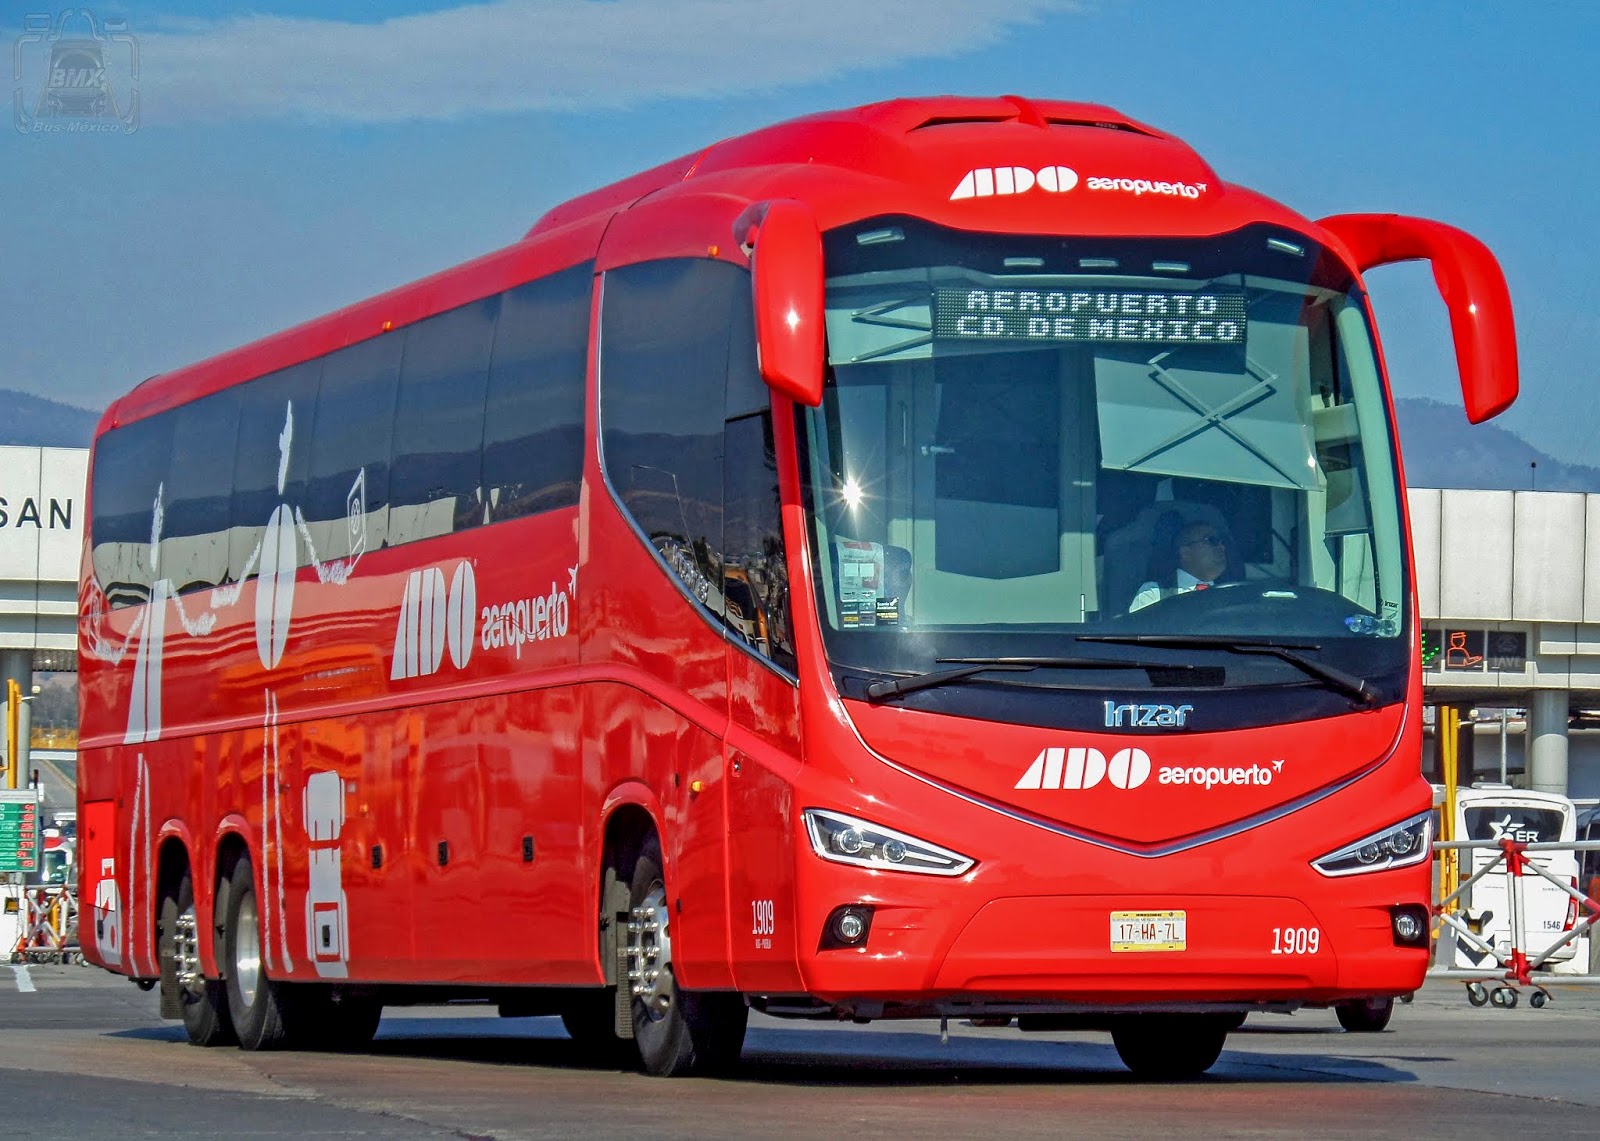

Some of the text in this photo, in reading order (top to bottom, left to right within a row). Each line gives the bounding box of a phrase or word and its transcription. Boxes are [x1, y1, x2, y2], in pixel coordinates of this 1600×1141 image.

[949, 165, 1199, 201] ADO aeropuerto
[966, 289, 1218, 315] AEROPUERTO
[956, 315, 1238, 340] CD. DE MEXICO
[0, 496, 73, 530] SAN
[389, 560, 569, 681] ADO aeropuerto
[1013, 747, 1273, 790] ADO aeropuerto
[751, 899, 774, 935] 1909
[1119, 922, 1180, 940] 17-HA-7L
[1543, 920, 1561, 930] 1546
[1270, 927, 1320, 955] 1909
